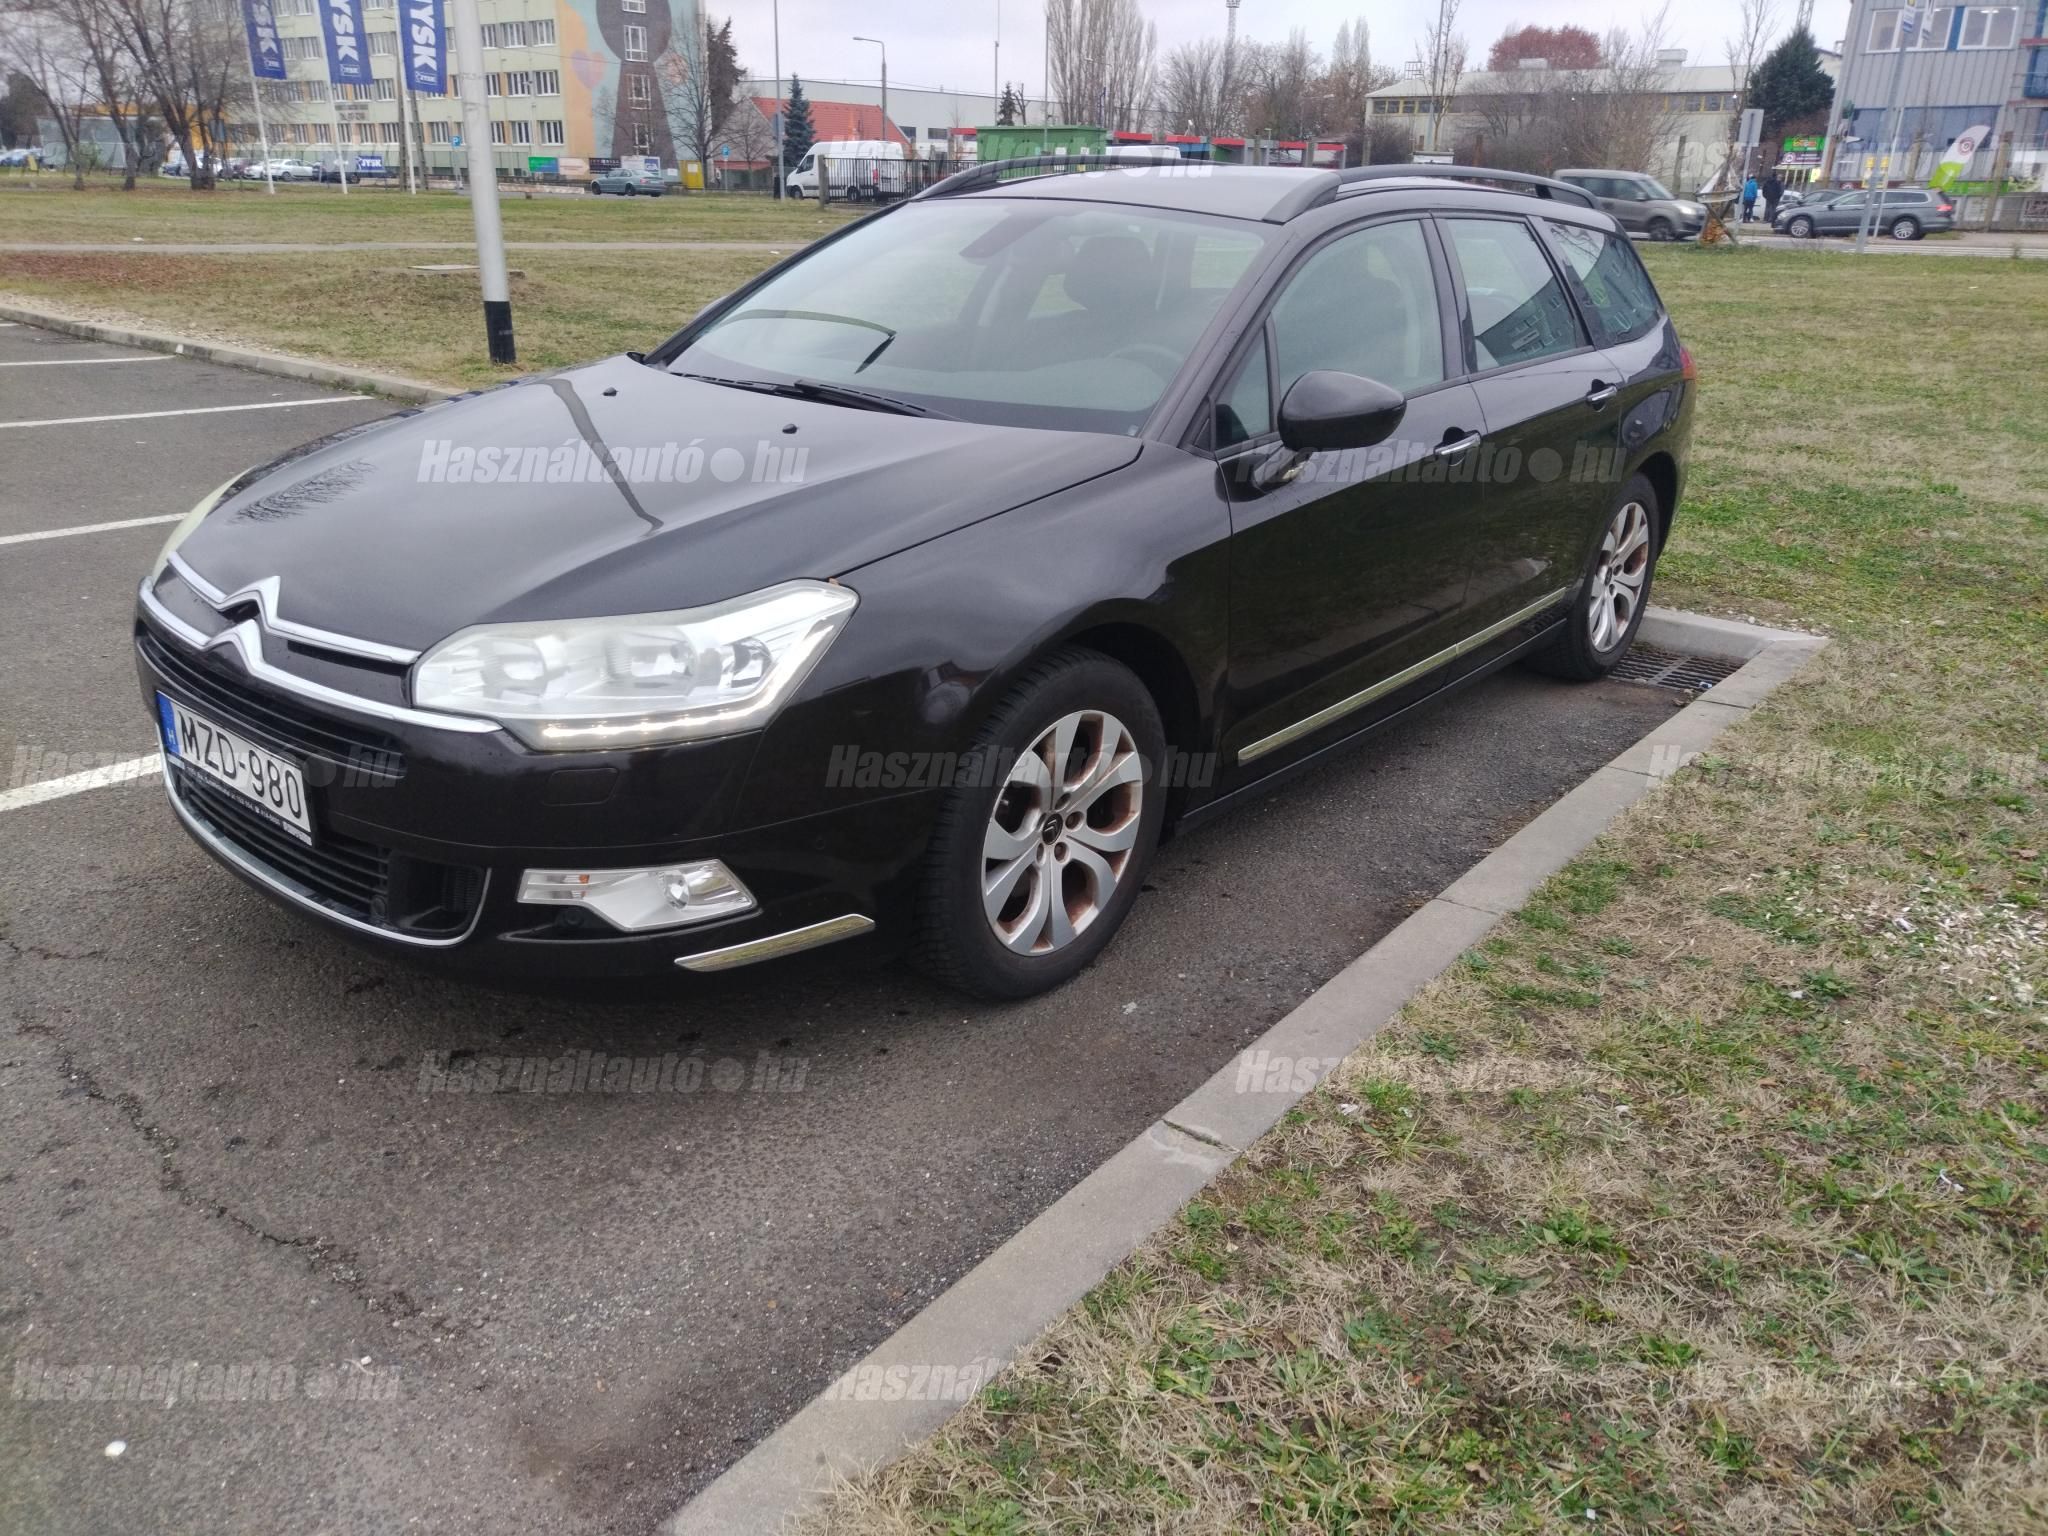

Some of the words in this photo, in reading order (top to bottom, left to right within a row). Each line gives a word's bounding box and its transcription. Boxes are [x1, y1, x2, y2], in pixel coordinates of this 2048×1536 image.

[252, 0, 278, 54] SK
[330, 0, 360, 62] YSK
[409, 0, 437, 71] YSK
[361, 159, 382, 167] JYSK
[167, 729, 176, 745] H
[178, 710, 302, 820] MZD-980
